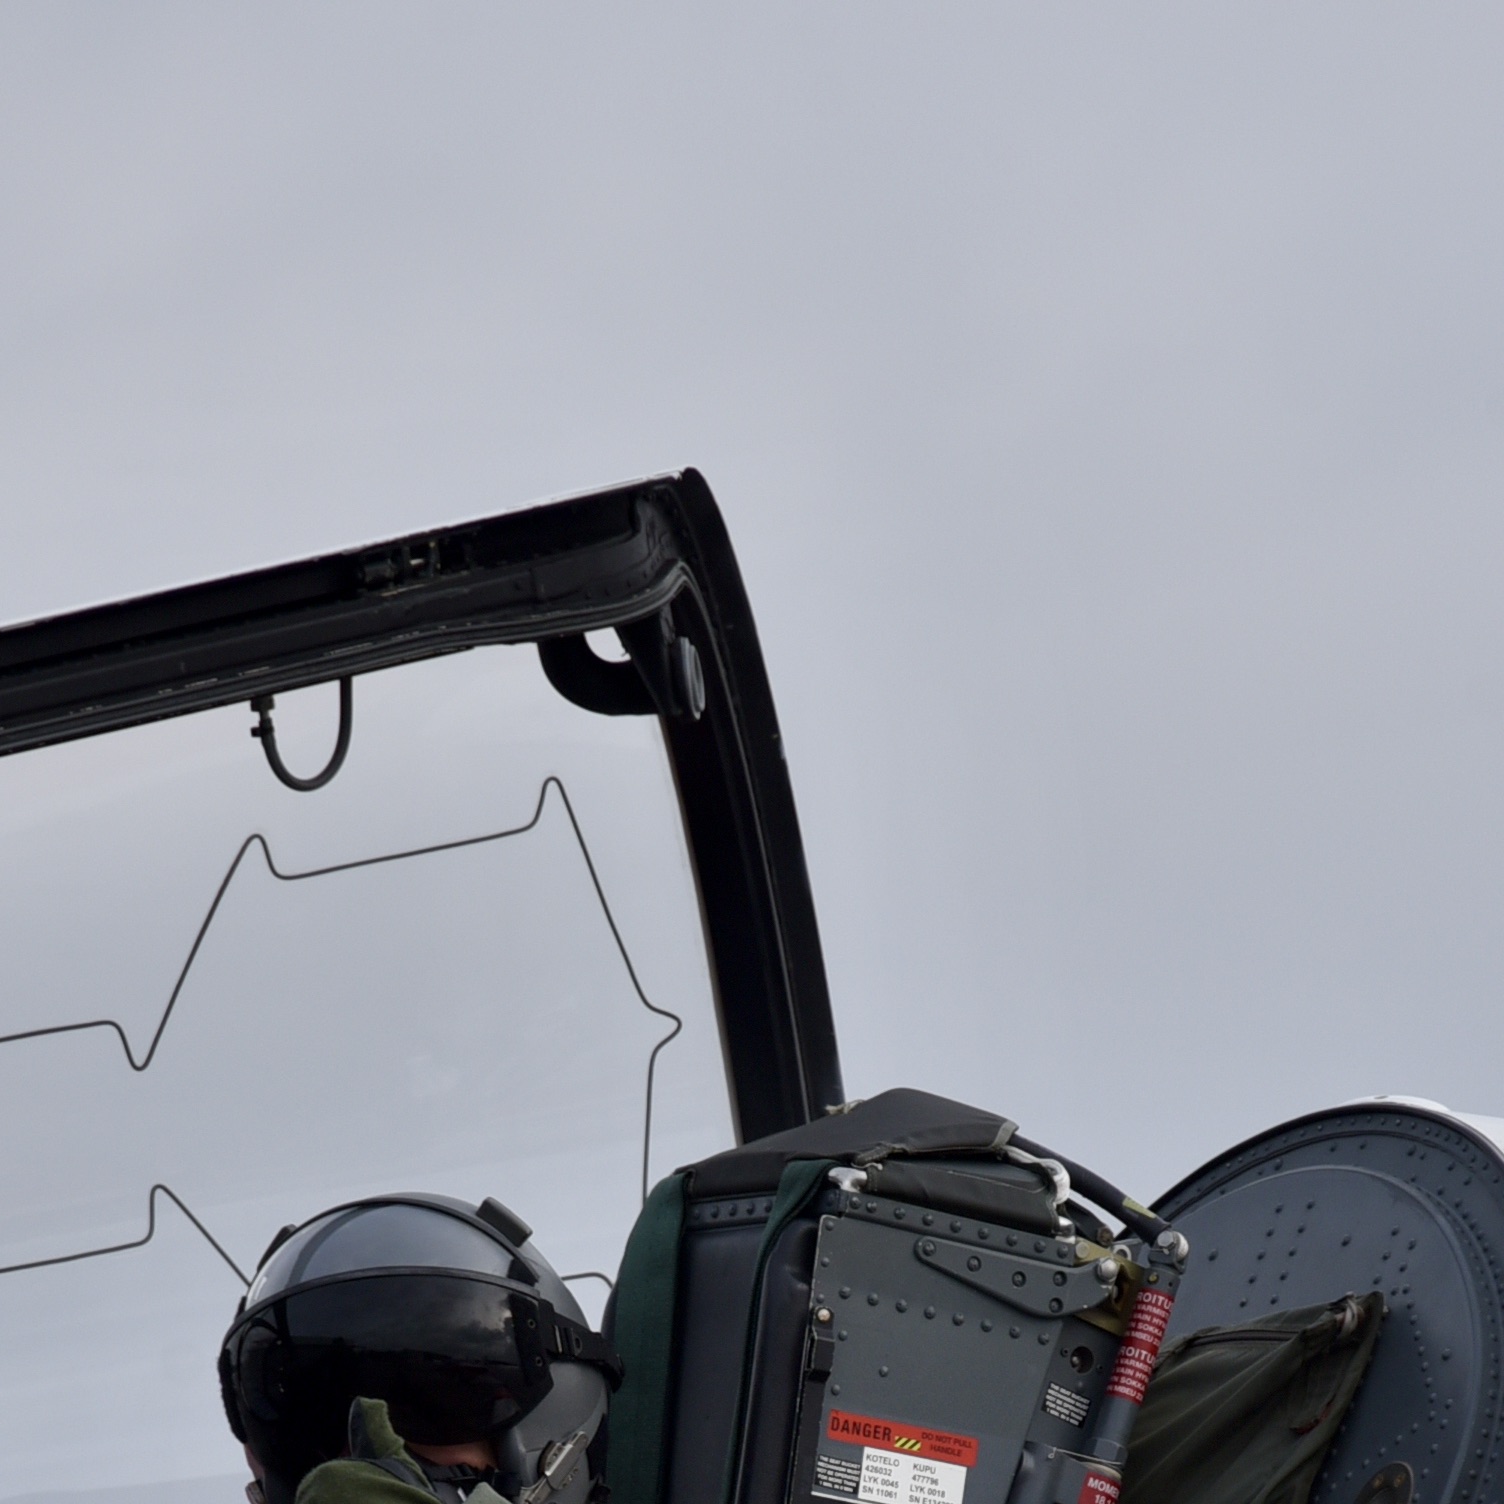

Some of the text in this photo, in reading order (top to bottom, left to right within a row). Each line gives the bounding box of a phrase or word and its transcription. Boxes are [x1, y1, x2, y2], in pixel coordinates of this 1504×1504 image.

[830, 1415, 893, 1442] DANGER
[921, 1431, 973, 1448] DO NOT PULL
[930, 1444, 963, 1457] HANDLE
[865, 1453, 900, 1467] KOTELO
[864, 1465, 893, 1477] 426032
[912, 1463, 937, 1475] KUPU
[862, 1474, 879, 1485] LYK
[911, 1474, 939, 1486] 477796
[862, 1485, 898, 1499] SN 11061
[909, 1484, 946, 1499] LYK 0018
[908, 1494, 921, 1504] SN
